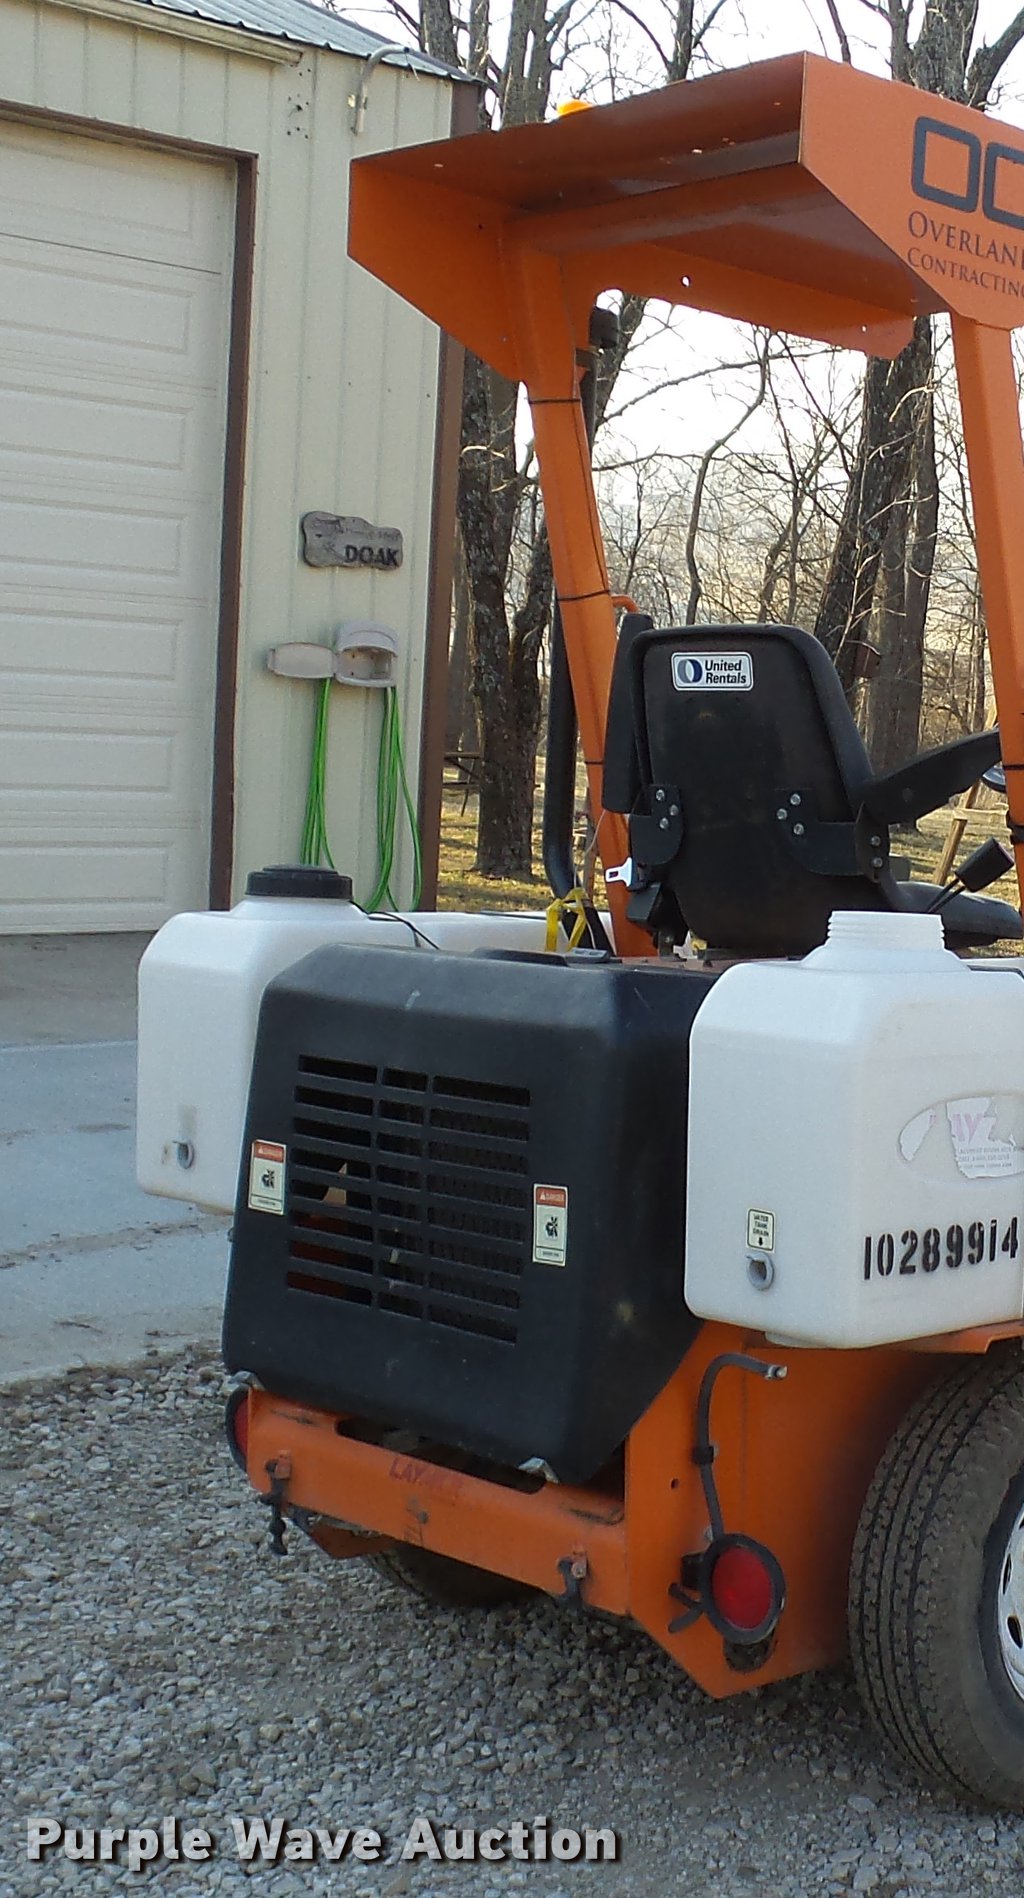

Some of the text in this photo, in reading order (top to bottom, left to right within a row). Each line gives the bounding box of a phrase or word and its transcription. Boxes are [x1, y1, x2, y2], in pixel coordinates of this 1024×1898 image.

[344, 544, 399, 567] DOAK
[705, 659, 742, 672] United
[705, 672, 747, 684] Rentals
[864, 1217, 1018, 1280] 10289914
